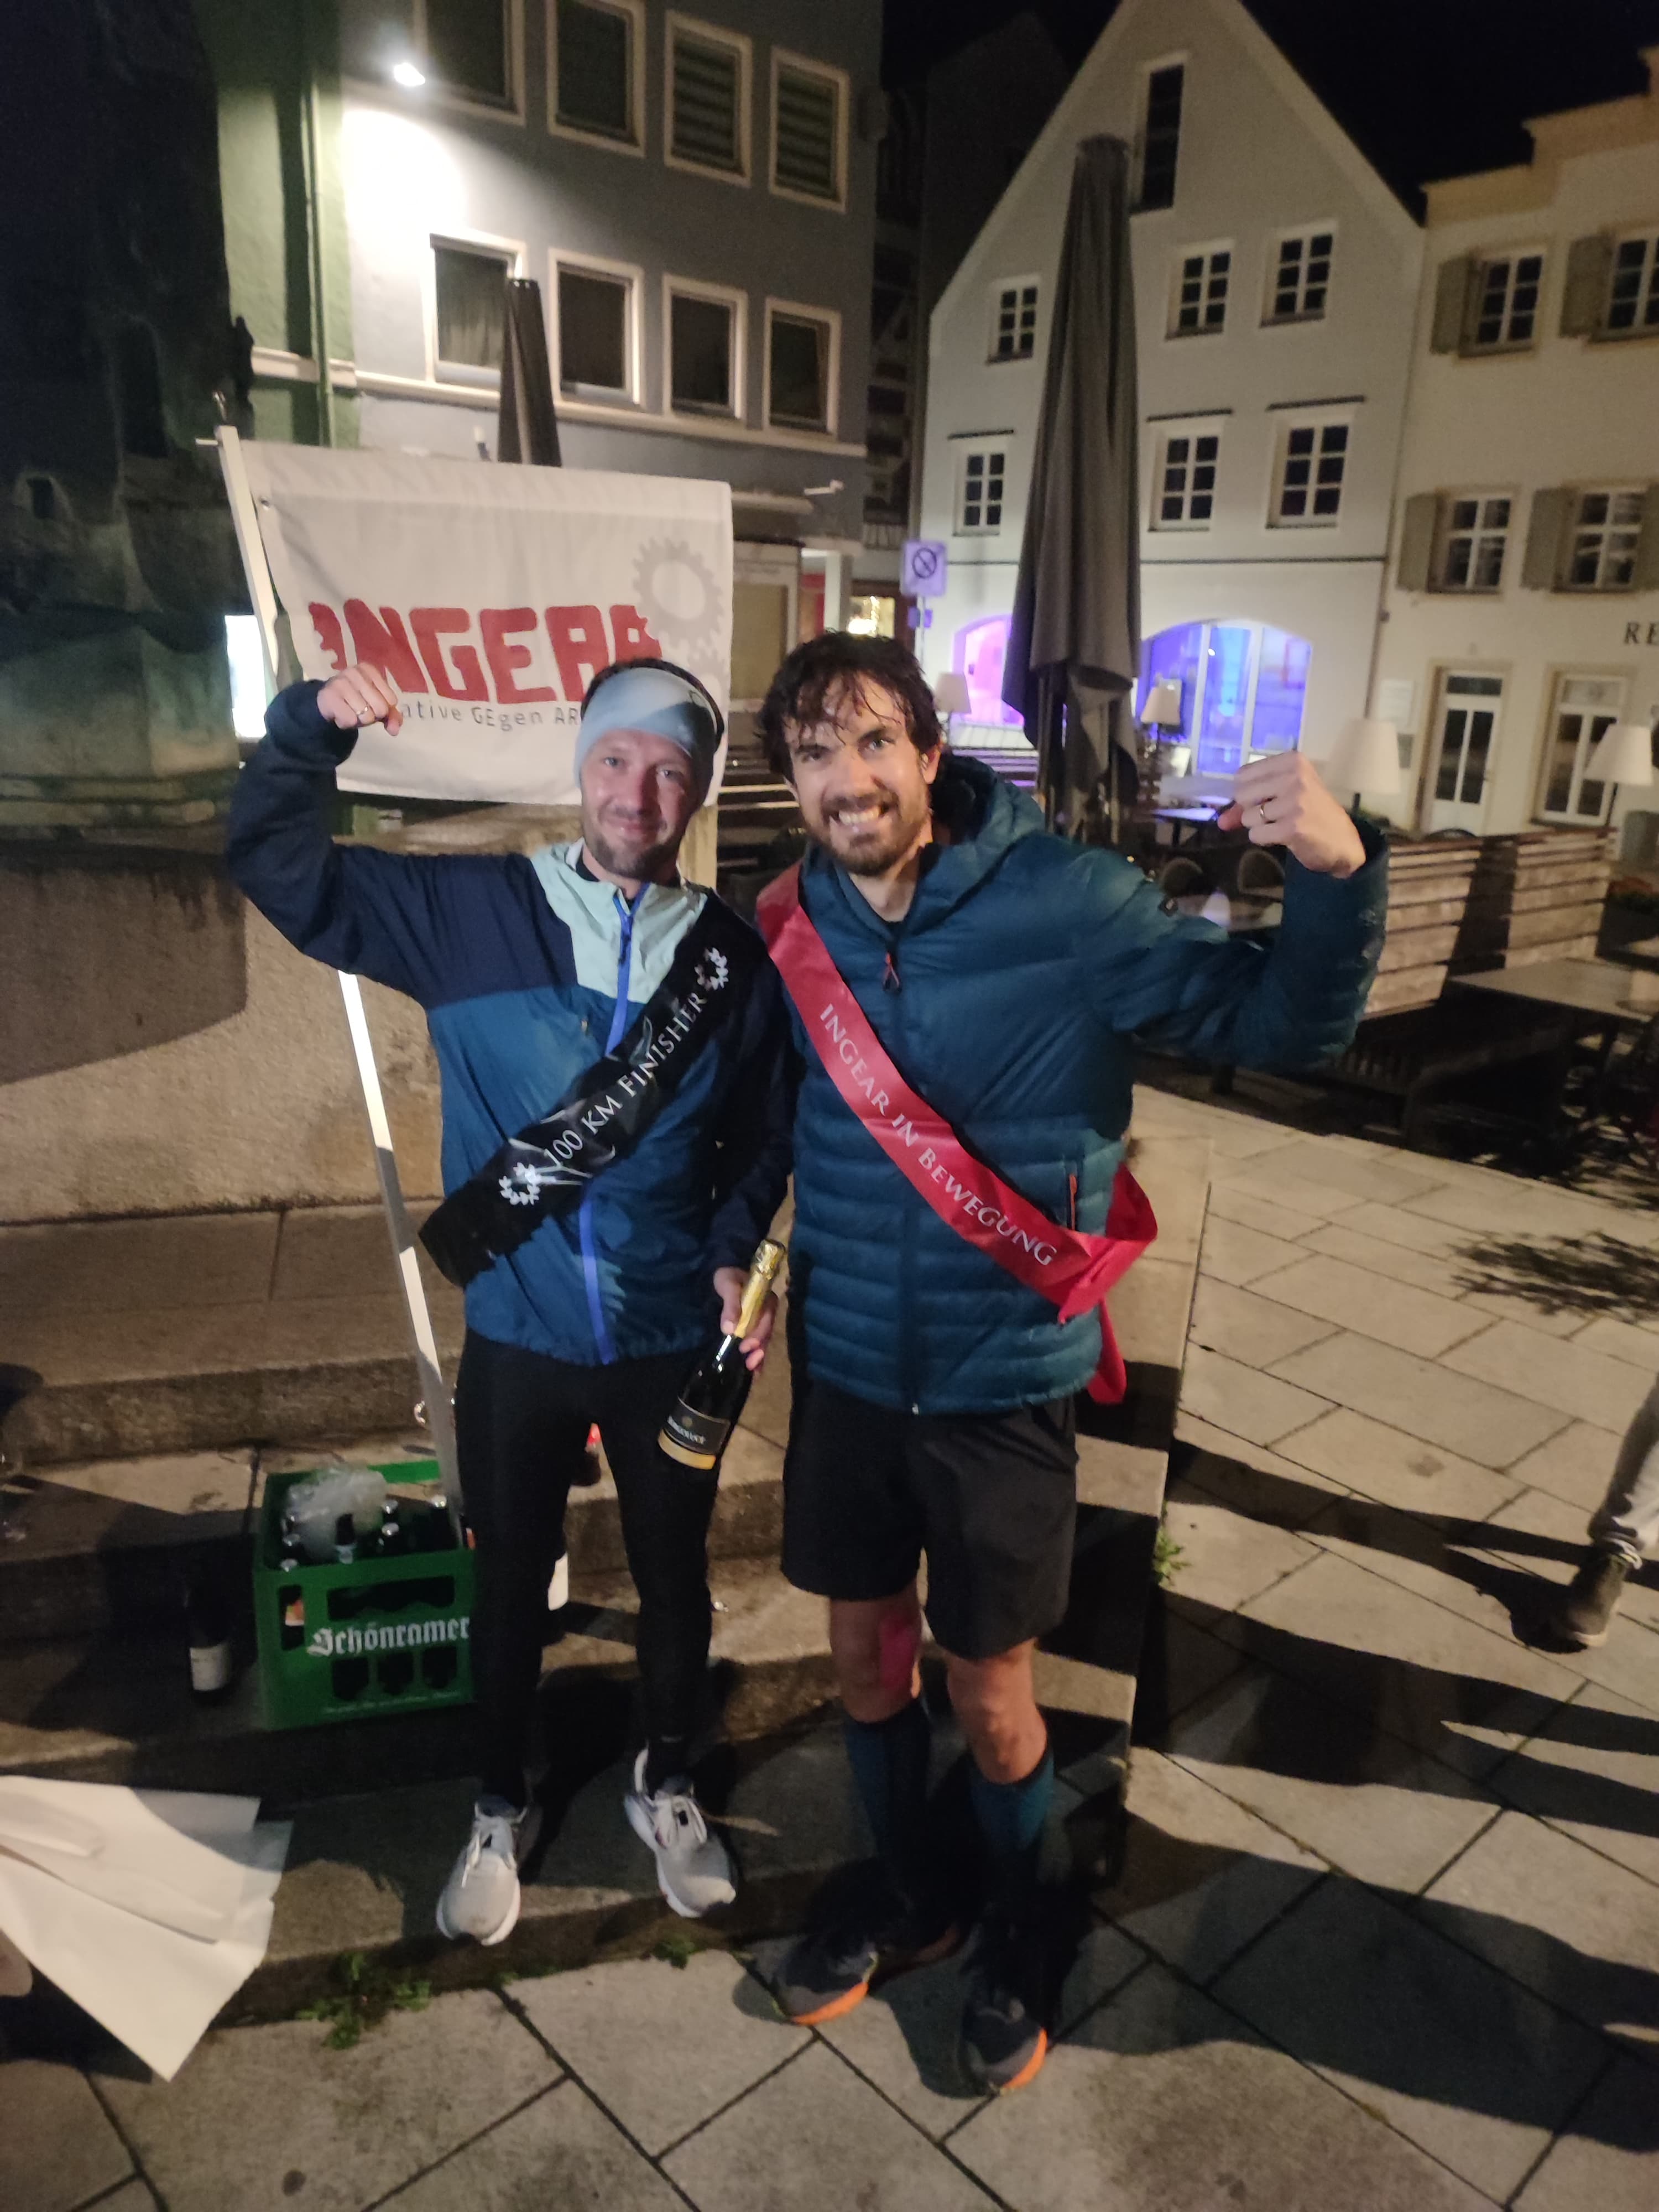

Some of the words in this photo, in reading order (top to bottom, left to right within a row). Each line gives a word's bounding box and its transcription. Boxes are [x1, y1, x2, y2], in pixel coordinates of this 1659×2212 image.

[471, 706, 544, 732] GEgen
[555, 707, 580, 725] AR
[544, 1129, 583, 1168] 100
[581, 1094, 623, 1136] KM
[617, 992, 708, 1098] FINISHER
[820, 1003, 890, 1116] INGEAR
[891, 1113, 919, 1147] IN
[917, 1147, 1057, 1266] BEWEGUNG
